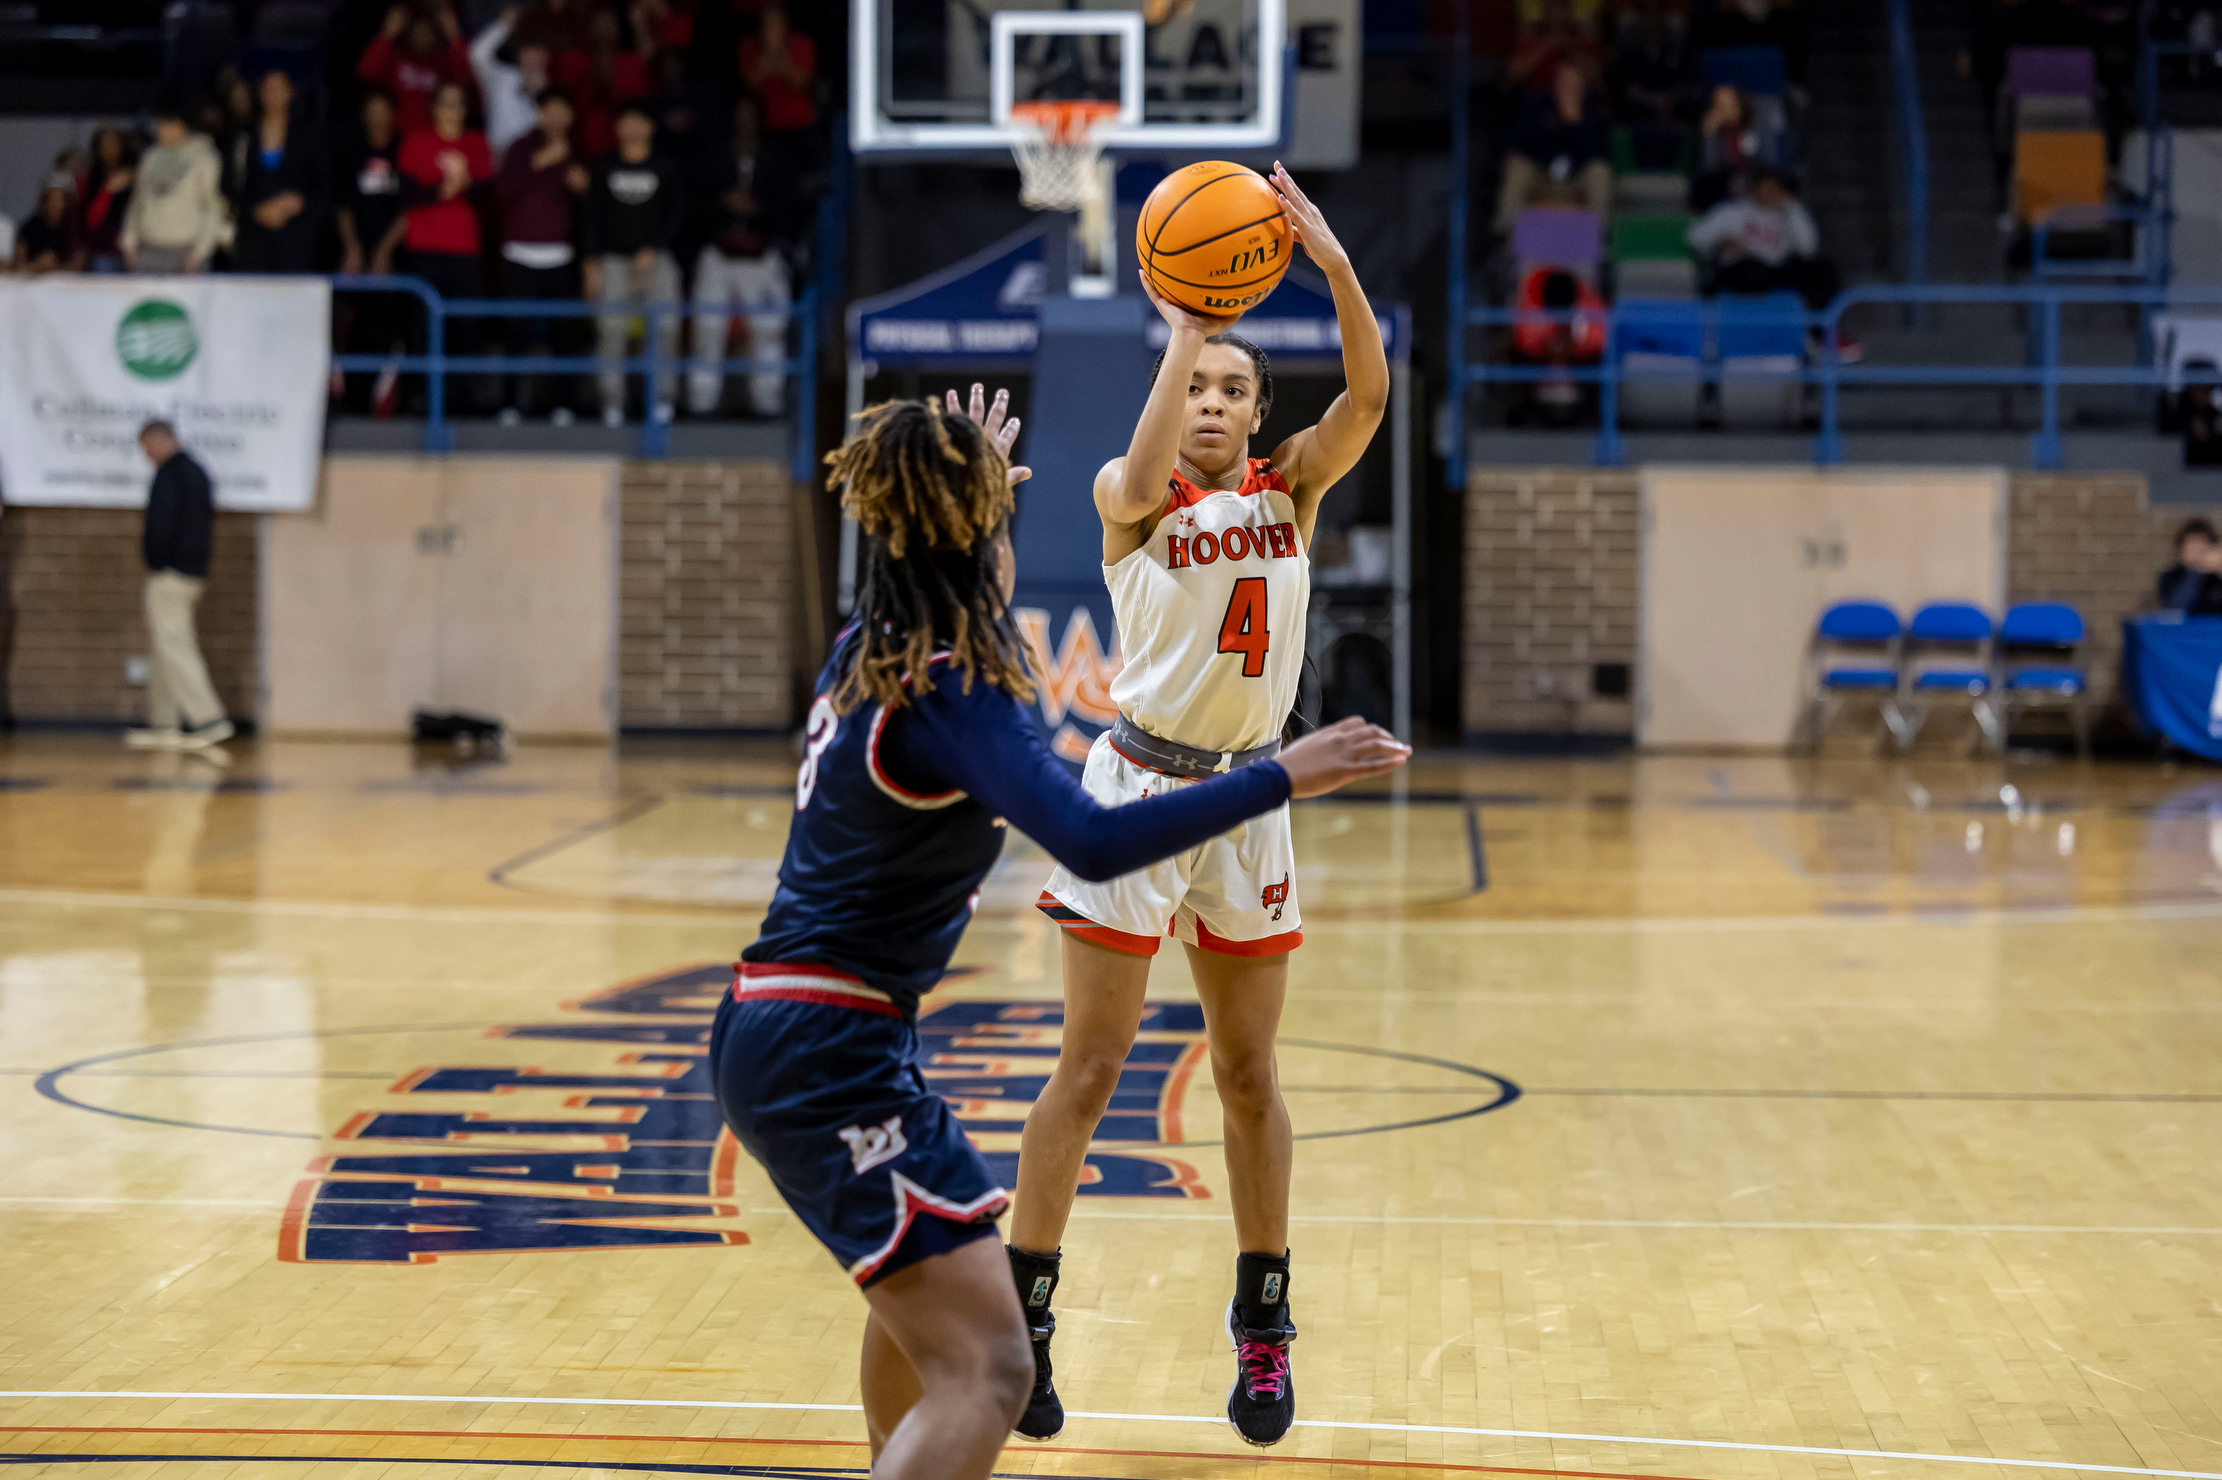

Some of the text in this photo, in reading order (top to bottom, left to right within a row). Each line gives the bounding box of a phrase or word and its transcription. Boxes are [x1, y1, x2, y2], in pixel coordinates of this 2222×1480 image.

[1167, 522, 1298, 569] HOOVER
[1217, 577, 1270, 677] 4
[1272, 886, 1283, 901] H
